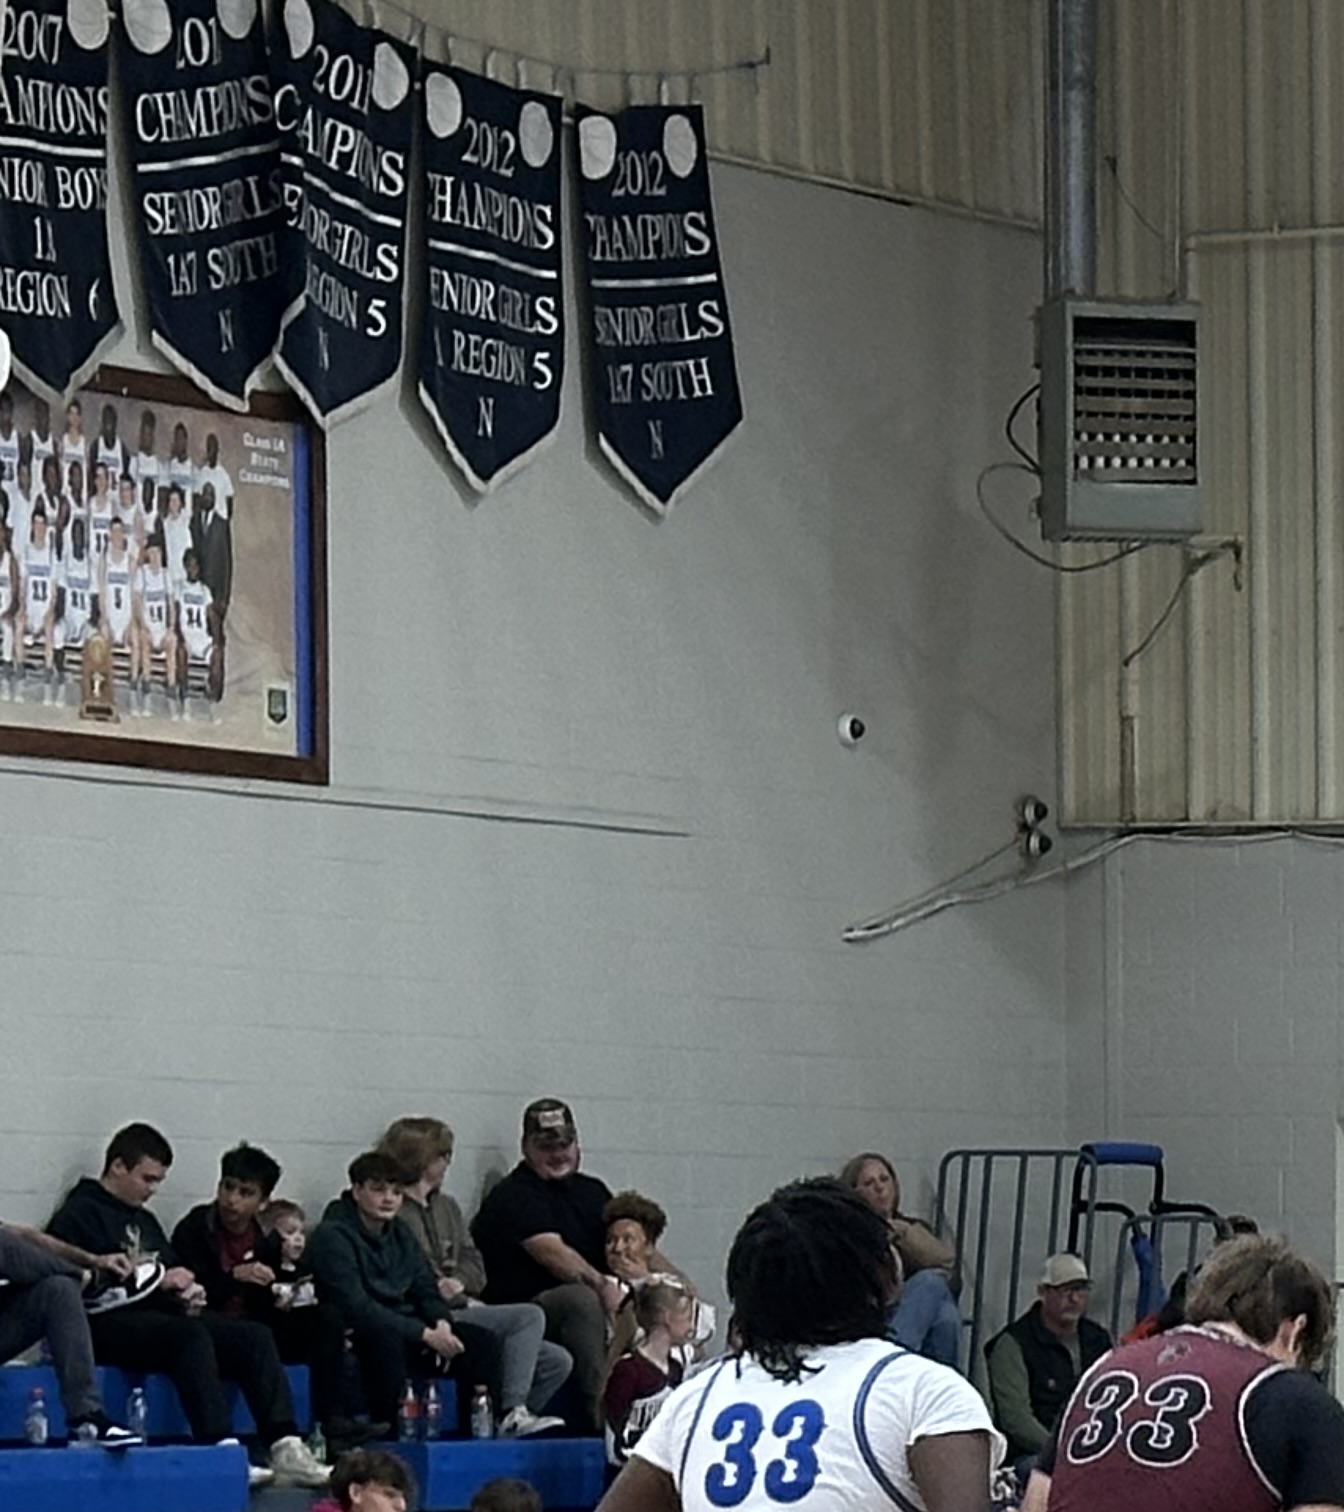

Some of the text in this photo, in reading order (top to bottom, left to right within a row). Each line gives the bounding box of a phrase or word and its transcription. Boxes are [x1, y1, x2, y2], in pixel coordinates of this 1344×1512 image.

[461, 117, 516, 178] 2012
[612, 150, 667, 197] 2012
[366, 298, 388, 337] 5
[533, 352, 553, 390] 5
[477, 396, 494, 438] N
[1066, 1369, 1213, 1468] 33
[703, 1399, 824, 1509] 33
